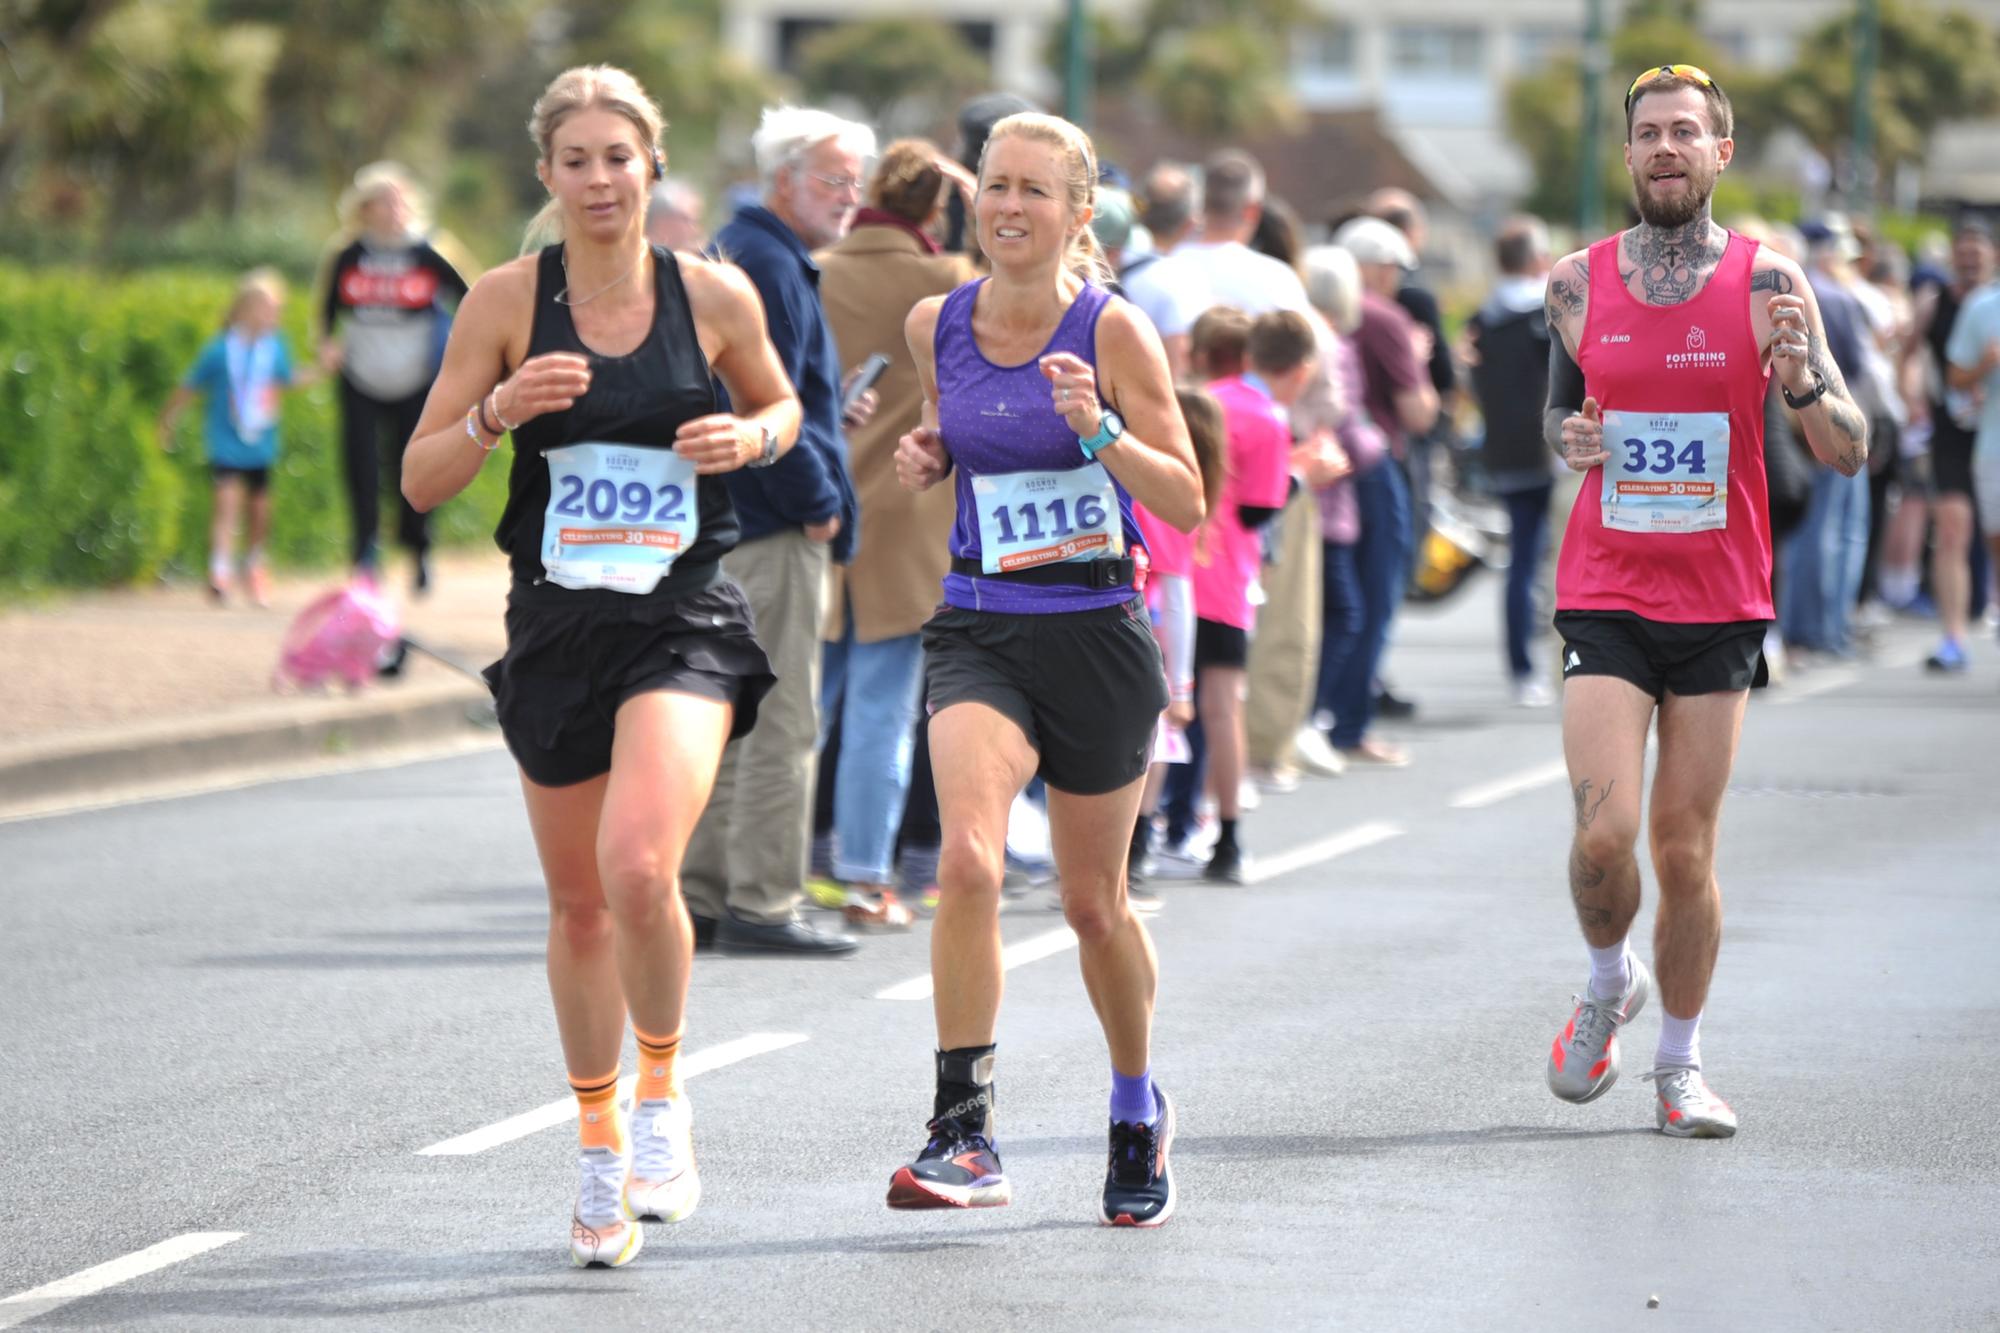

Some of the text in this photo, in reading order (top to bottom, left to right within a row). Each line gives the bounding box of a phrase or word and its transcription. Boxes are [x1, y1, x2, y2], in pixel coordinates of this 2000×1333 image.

[1610, 335, 1631, 343] JAKO
[1666, 352, 1726, 363] FOSTERING
[1622, 438, 1706, 475] 334
[554, 474, 687, 523] 2092
[1619, 483, 1712, 494] CELEBRATING 30 YEARS
[992, 494, 1107, 544] 1116
[562, 531, 675, 545] CELEBRATING 30 YEARS
[1002, 550, 1057, 567] CELEBRATING
[1059, 542, 1076, 558] 30
[944, 1094, 987, 1119] IRCAS
